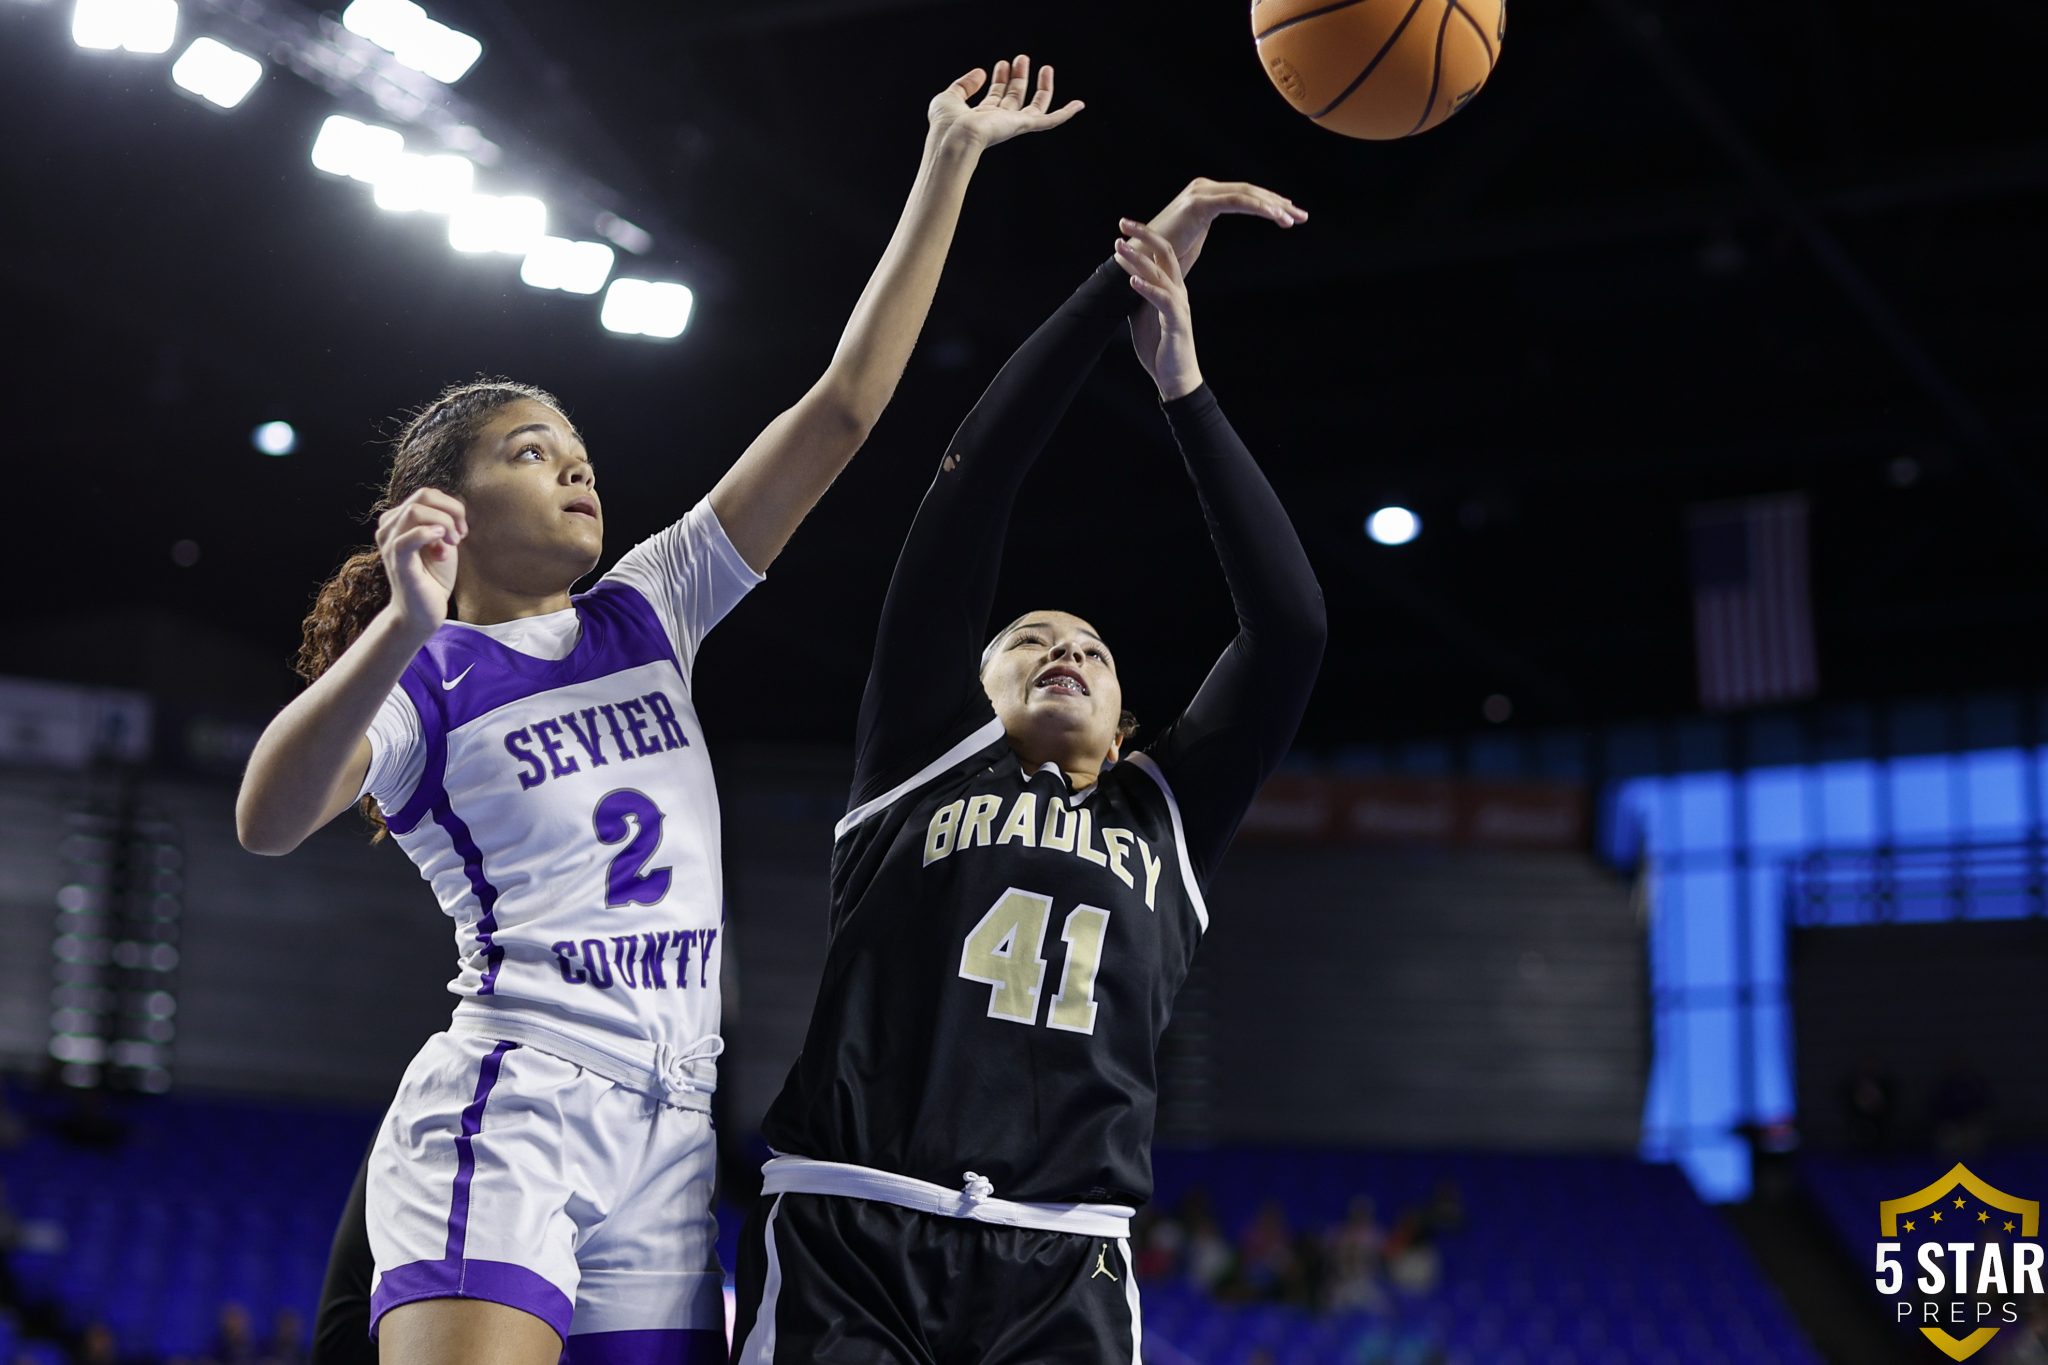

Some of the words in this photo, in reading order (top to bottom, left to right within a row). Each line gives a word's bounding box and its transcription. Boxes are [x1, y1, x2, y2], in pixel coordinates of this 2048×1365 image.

[504, 691, 690, 791] SEVIER
[593, 787, 673, 909] 2
[923, 792, 1161, 912] BRADLEY
[551, 929, 717, 990] COUNTY
[958, 887, 1111, 1035] 41
